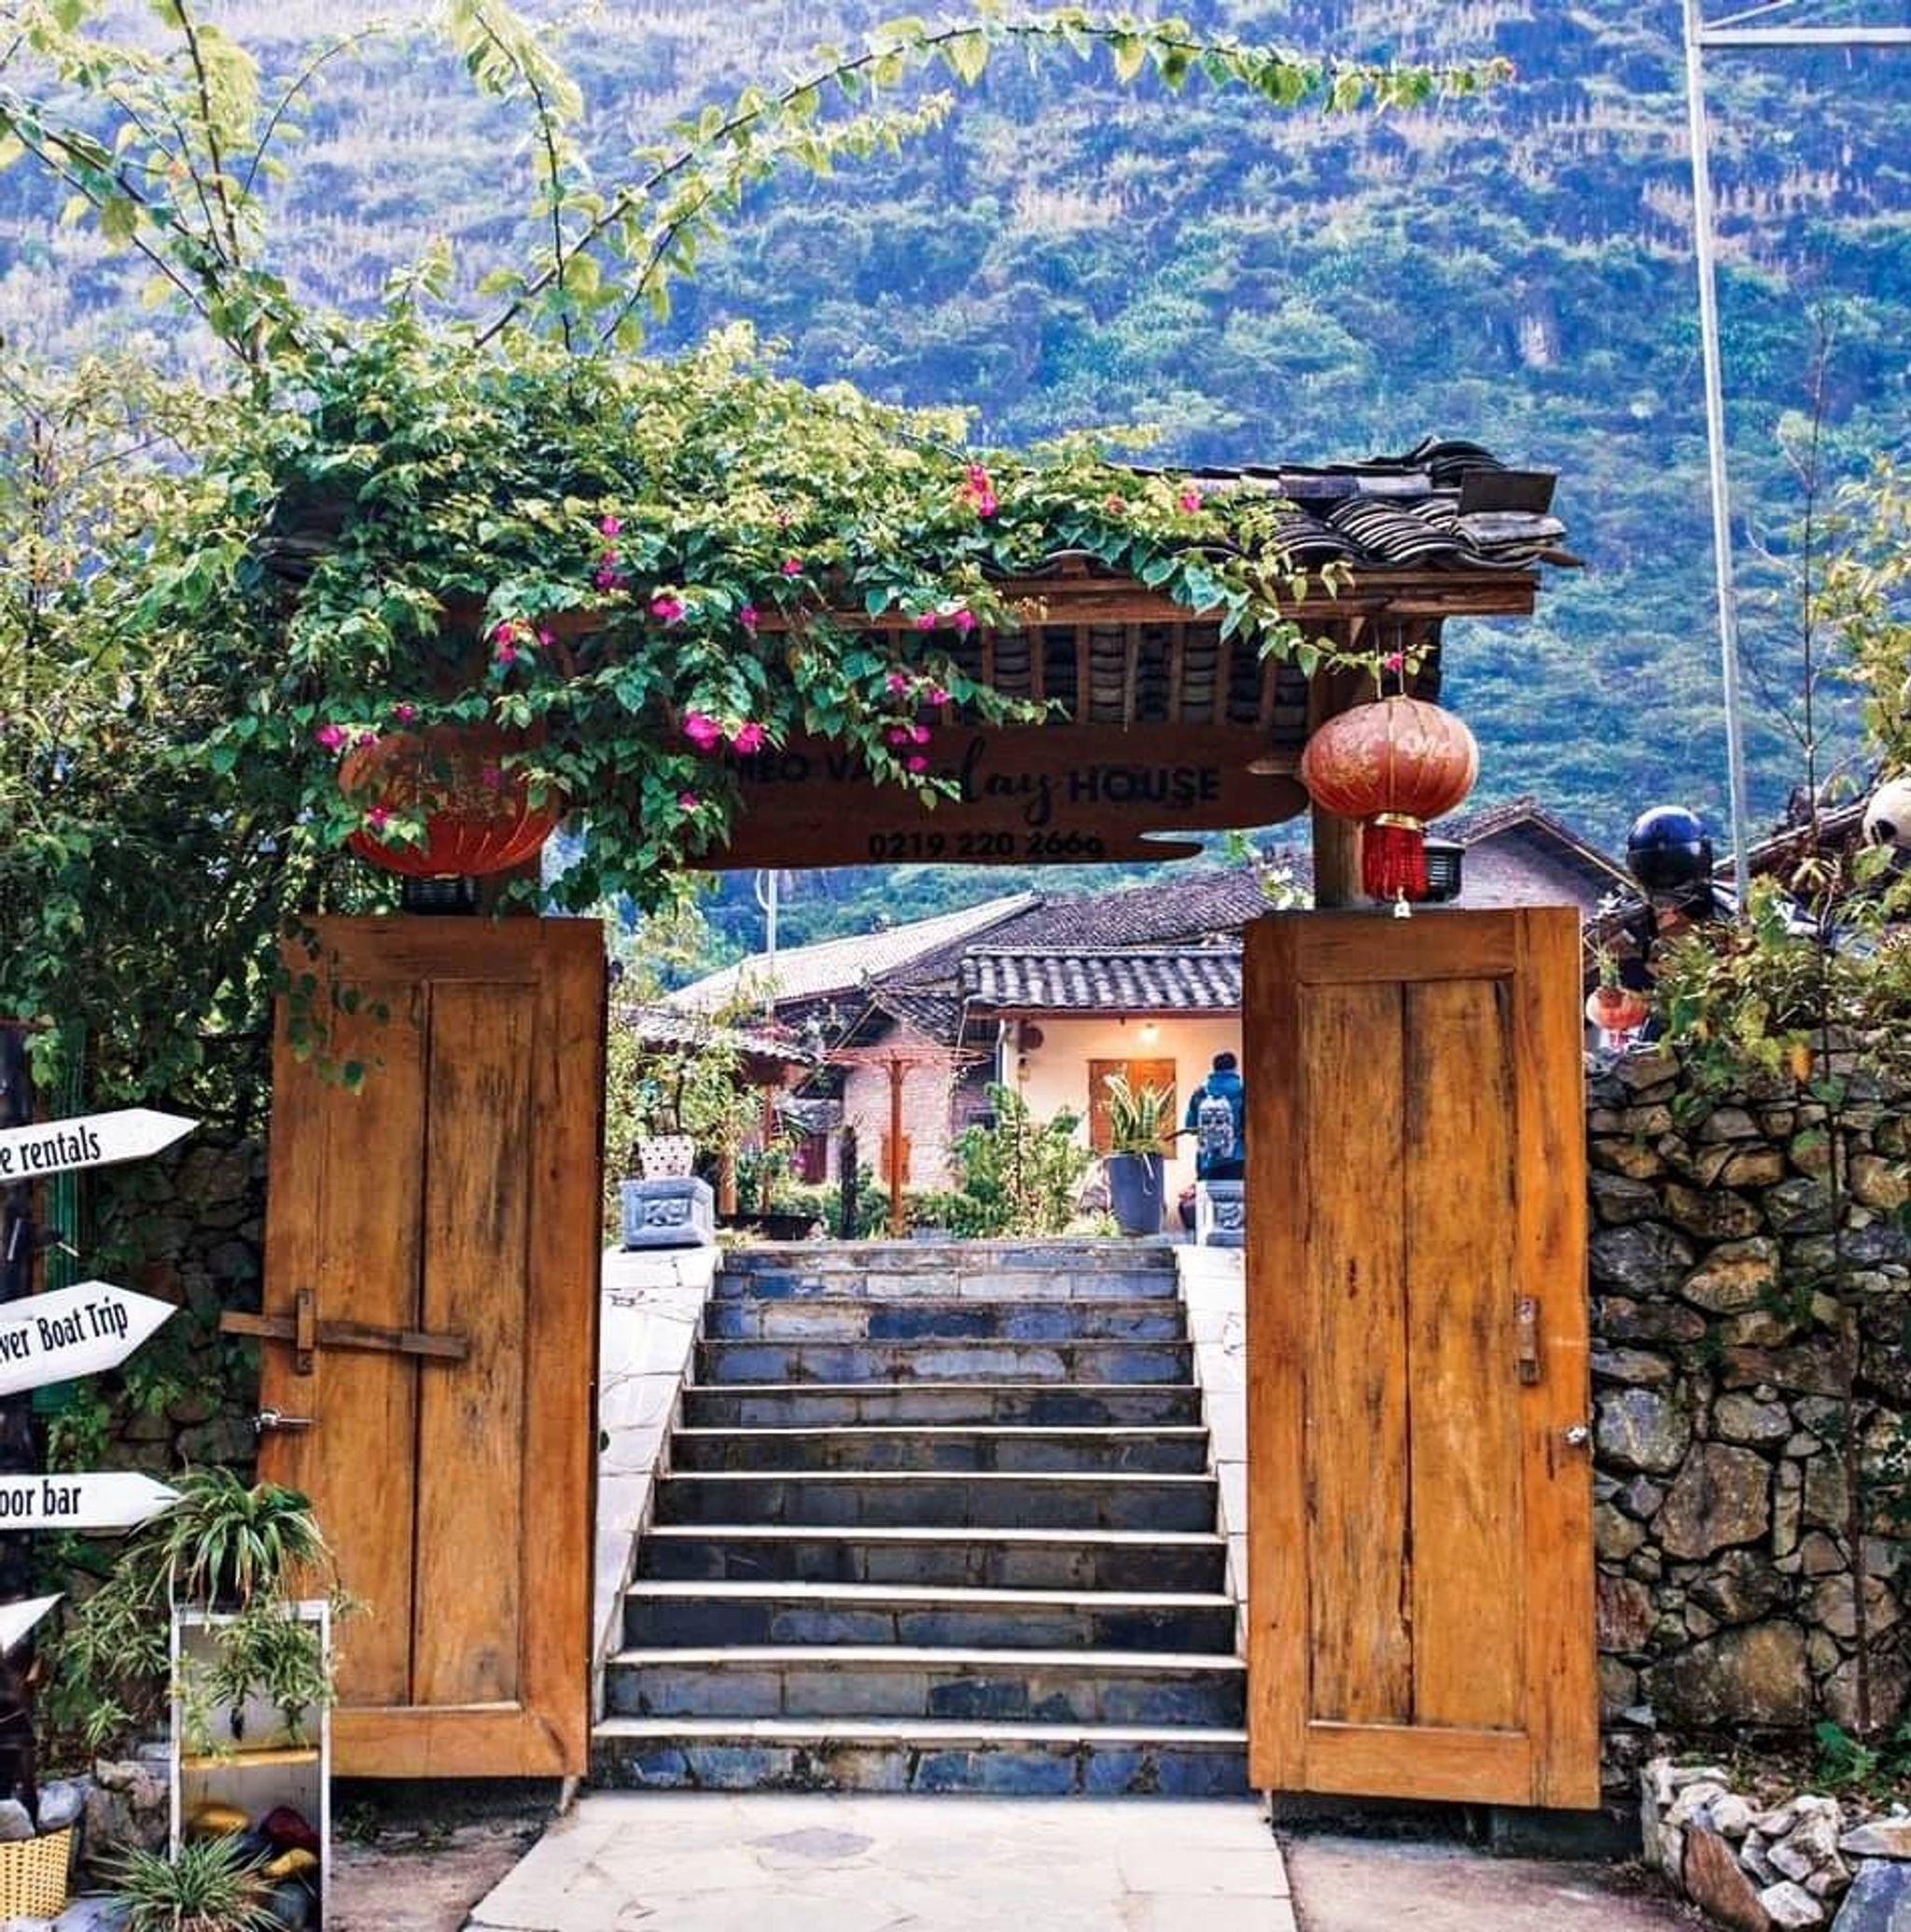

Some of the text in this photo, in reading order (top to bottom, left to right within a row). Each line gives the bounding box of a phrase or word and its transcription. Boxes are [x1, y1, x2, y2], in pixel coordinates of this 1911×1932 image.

[939, 736, 1052, 826] lay
[1067, 765, 1221, 805] HOUSE
[869, 831, 945, 857] 0219
[956, 831, 1014, 856] 220
[0, 1125, 101, 1174] e rentals
[0, 1295, 128, 1362] ver Boat Trip
[42, 1478, 82, 1517] bar
